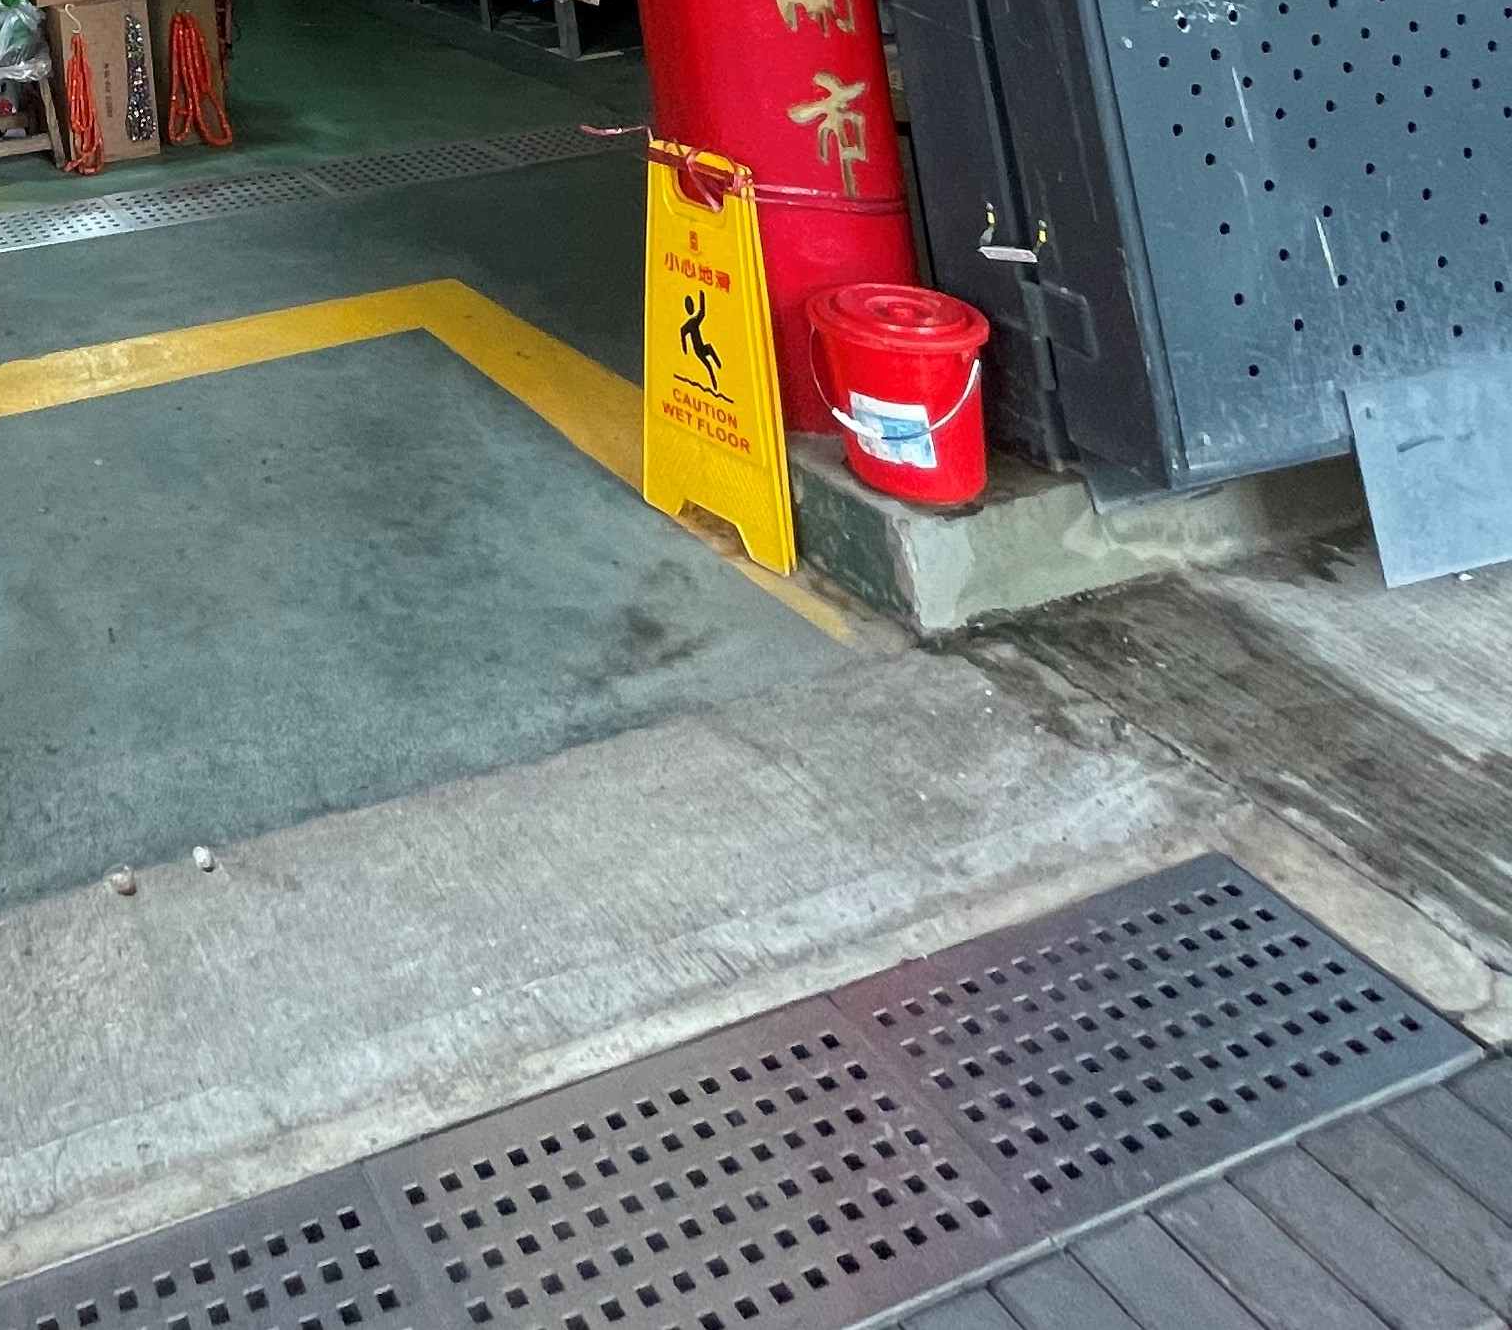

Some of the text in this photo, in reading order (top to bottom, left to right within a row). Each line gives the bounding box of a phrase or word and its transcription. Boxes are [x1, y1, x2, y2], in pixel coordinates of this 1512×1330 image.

[663, 400, 751, 454] WET FLOOR
[672, 388, 738, 430] CAUTION
